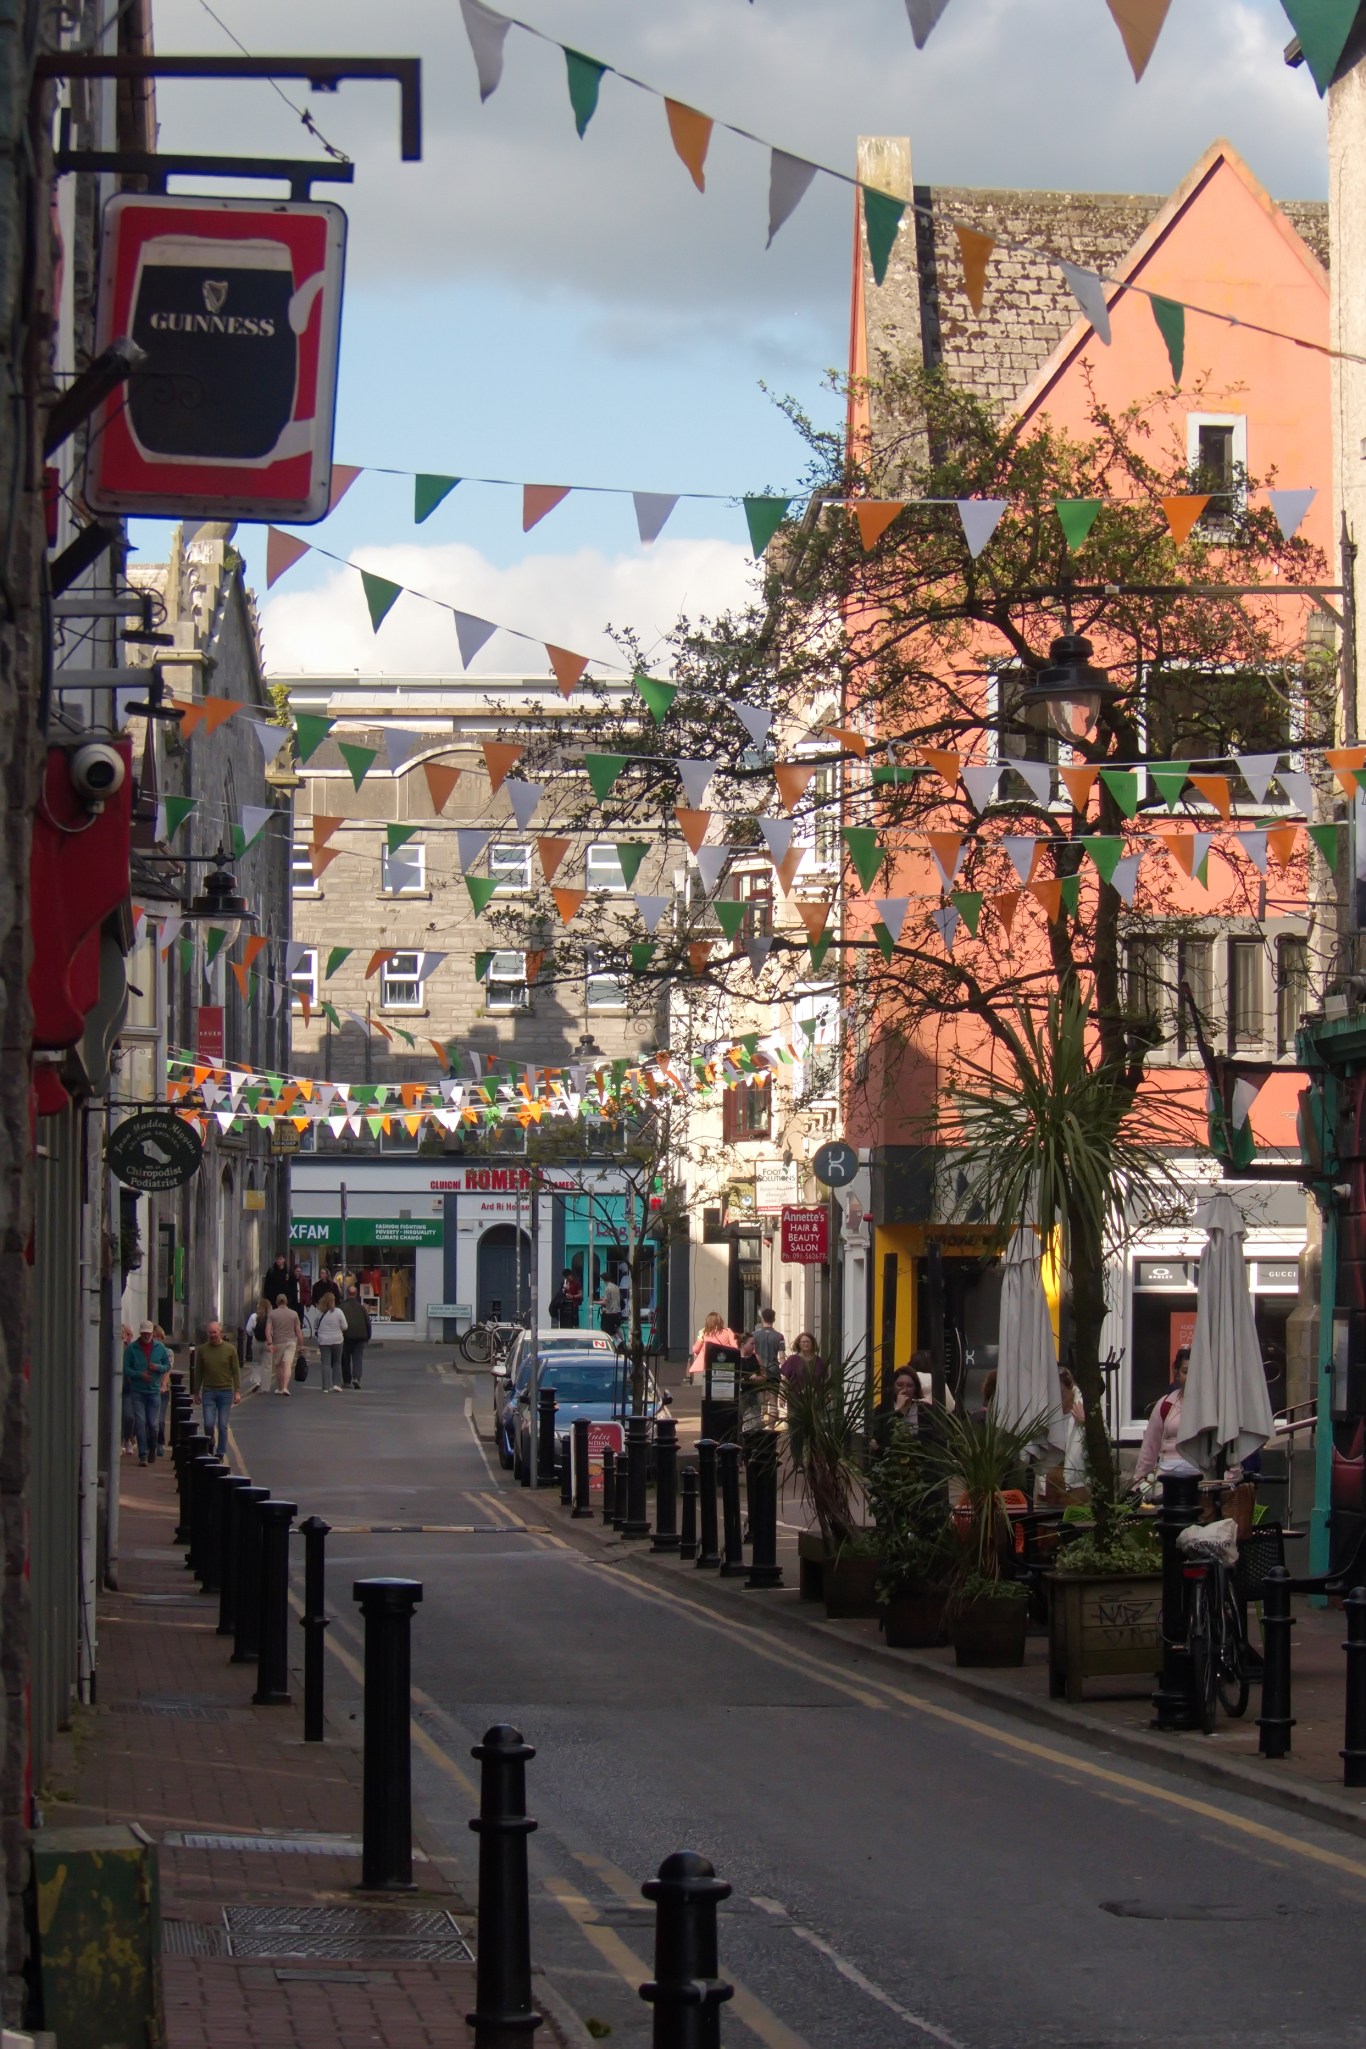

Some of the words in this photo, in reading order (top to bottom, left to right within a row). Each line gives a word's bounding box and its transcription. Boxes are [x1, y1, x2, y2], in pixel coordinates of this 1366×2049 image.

[150, 312, 275, 336] GUINNESS
[126, 1165, 183, 1180] Chiropodist
[130, 1177, 179, 1188] Podiatrist
[465, 1169, 545, 1190] ROMER
[480, 1202, 494, 1210] Ard
[506, 1202, 530, 1210] Hose
[783, 1211, 825, 1222] Annette's
[289, 1225, 329, 1239] XFAM
[790, 1223, 811, 1232] HAIR
[812, 1223, 819, 1232] &
[788, 1233, 821, 1242] BEAUTY
[790, 1243, 819, 1252] SALON
